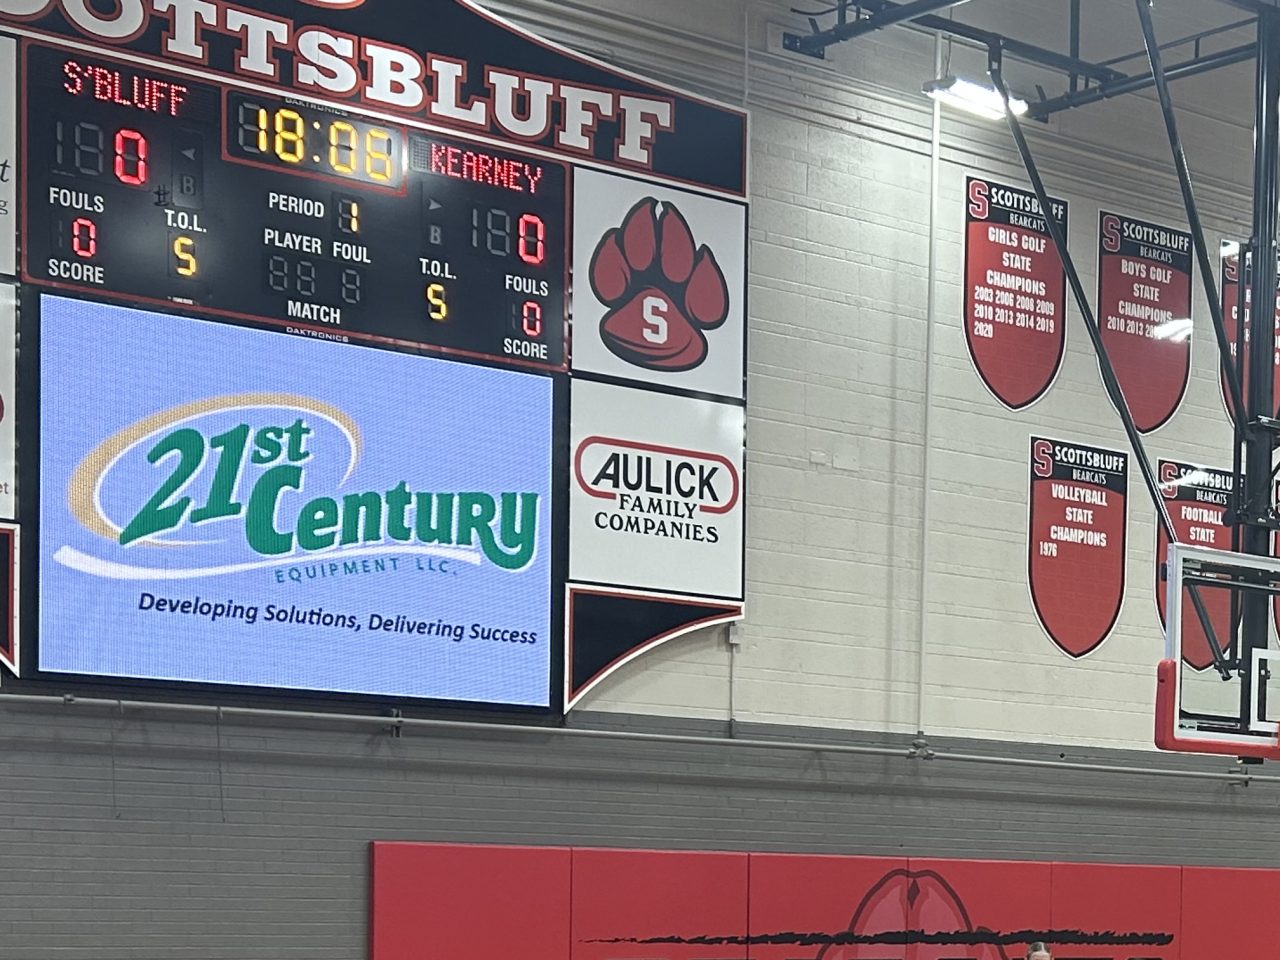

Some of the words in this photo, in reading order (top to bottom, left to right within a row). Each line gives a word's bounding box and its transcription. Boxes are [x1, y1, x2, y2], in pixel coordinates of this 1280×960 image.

[63, 60, 188, 116] S'BLUFF
[114, 129, 147, 185] 0
[258, 108, 392, 182] 18:06
[430, 143, 543, 194] KEARNEY
[50, 186, 105, 213] FOULS
[269, 192, 325, 219] PERIOD
[990, 187, 1064, 220] SCOTTSBLFF
[164, 209, 208, 233] T.O.L.
[1009, 213, 1046, 232] BEARCATS
[72, 217, 97, 258] 0
[264, 228, 322, 255] PLAYER
[332, 241, 372, 264] FOUL
[518, 213, 545, 265] 0
[988, 226, 1018, 248] GIRLS
[1021, 234, 1046, 254] GOLF
[1122, 221, 1189, 252] SCOTTSBLUFF
[173, 236, 197, 276] 5
[1002, 251, 1032, 272] STATE
[1140, 246, 1173, 263] BEARCATS
[48, 259, 104, 285] SCORE
[419, 257, 457, 280] T.O.L.
[1121, 259, 1147, 278] BOYS
[1149, 266, 1173, 284] GOLF
[505, 274, 549, 297] FOULS
[986, 269, 1046, 296] CHAMPIONS
[1133, 282, 1160, 302] STATE
[287, 300, 341, 325] MATCH
[426, 283, 447, 320] 5
[1118, 300, 1173, 323] CHAMPIONS
[521, 300, 541, 336] 0
[642, 296, 668, 345] S
[974, 321, 994, 338] 2020
[995, 307, 1014, 325] 2013
[1016, 312, 1035, 329] 2014
[1036, 316, 1054, 334] 2019
[1107, 315, 1125, 332] 2010
[1126, 320, 1144, 336] 2013
[286, 326, 349, 343] DAKTRONICS
[503, 337, 548, 360] SCORE
[1054, 445, 1125, 472] SCOTTSBLUFF
[119, 419, 312, 546] 21st
[591, 452, 720, 502] AULICK
[1072, 469, 1107, 485] BEARCATS
[618, 493, 699, 520] FAMILY
[1051, 483, 1108, 507] VOLLEYBALL
[1196, 490, 1227, 505] BEARCATS
[594, 511, 719, 544] COMPANIES
[1065, 506, 1094, 525] STATE
[1181, 505, 1224, 526] FOOTBALL
[1050, 525, 1107, 548] CHAMPIONS
[1189, 526, 1215, 543] STATE
[275, 557, 398, 583] EQUIPMENT
[416, 558, 458, 576] LLC.
[138, 592, 258, 624] Developing
[264, 604, 362, 632] Solutions,
[368, 612, 464, 641] Delivering
[469, 622, 537, 645] Success
